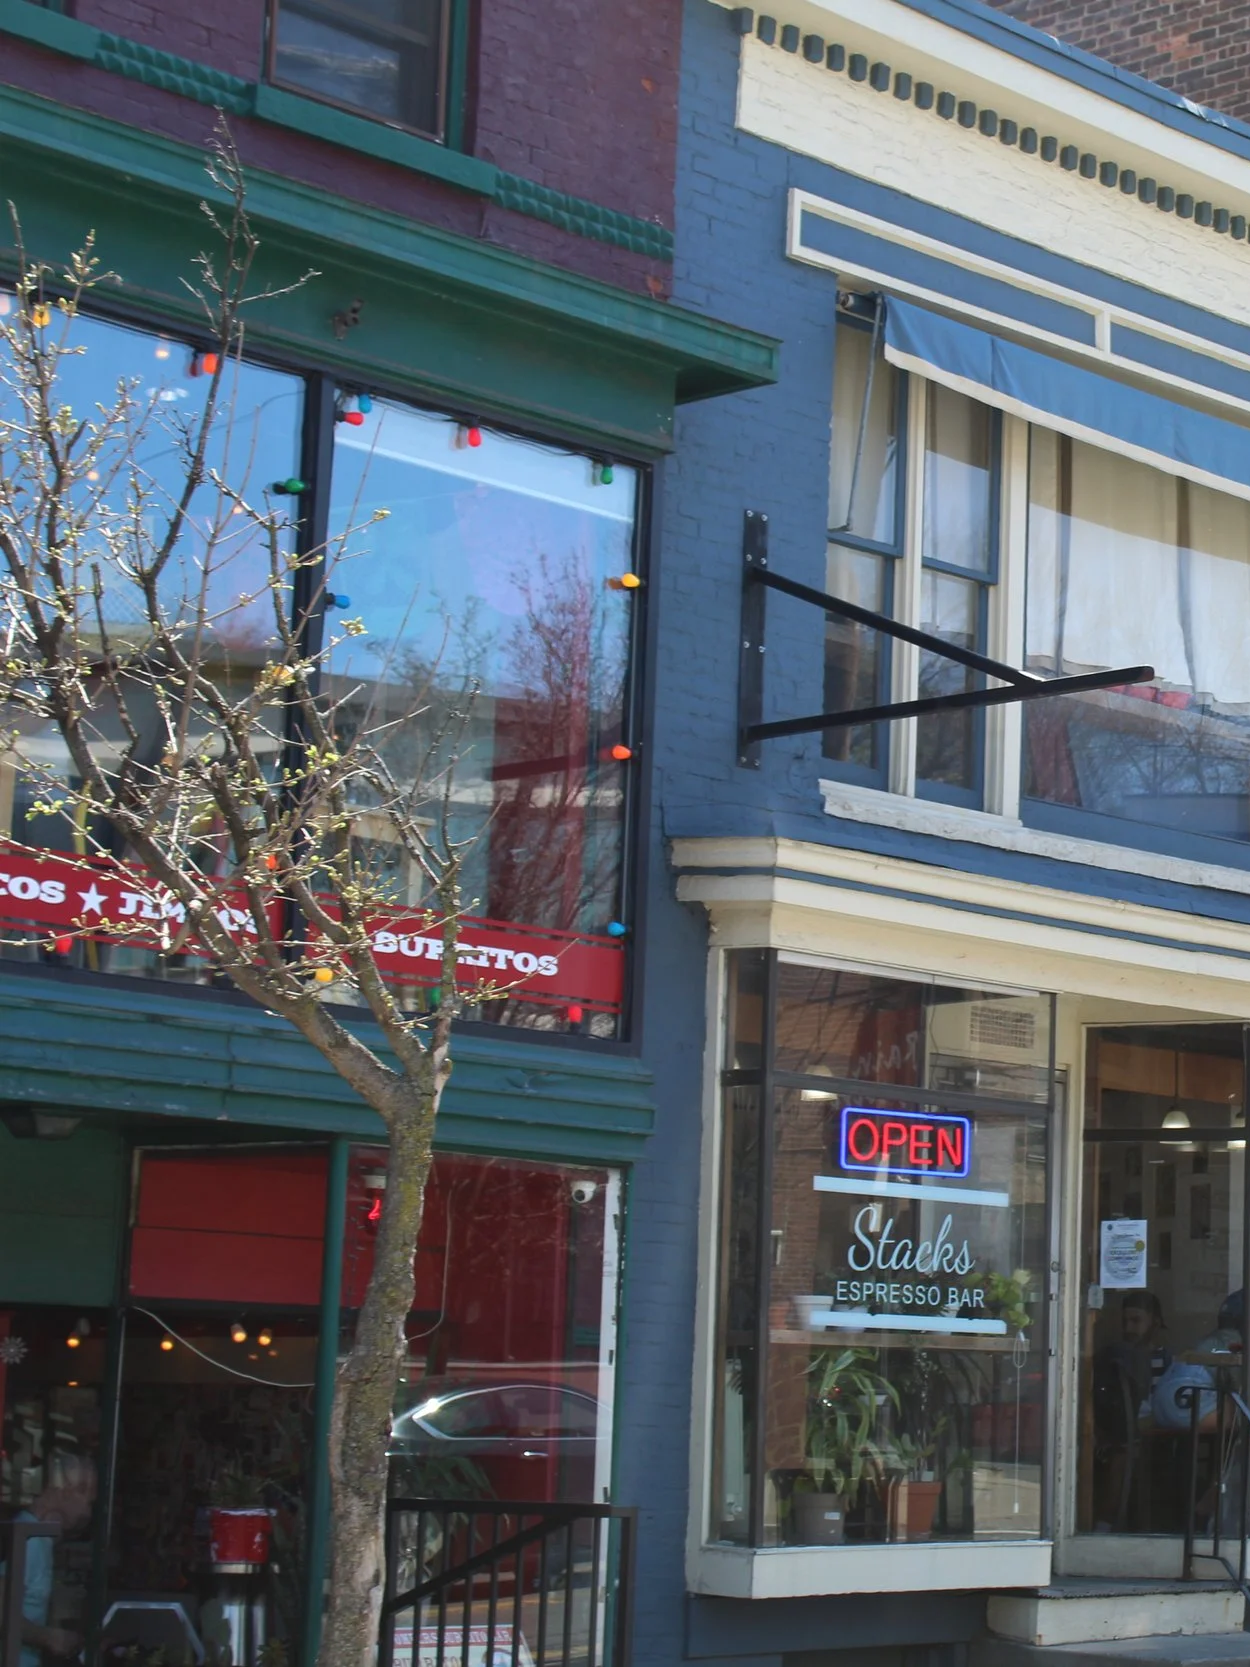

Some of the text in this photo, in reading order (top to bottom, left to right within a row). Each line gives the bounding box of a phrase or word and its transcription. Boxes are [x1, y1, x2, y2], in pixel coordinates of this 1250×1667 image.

[848, 1118, 962, 1166] OPEN
[847, 1204, 976, 1275] Stacks
[836, 1281, 985, 1308] ESPRESSO BAR
